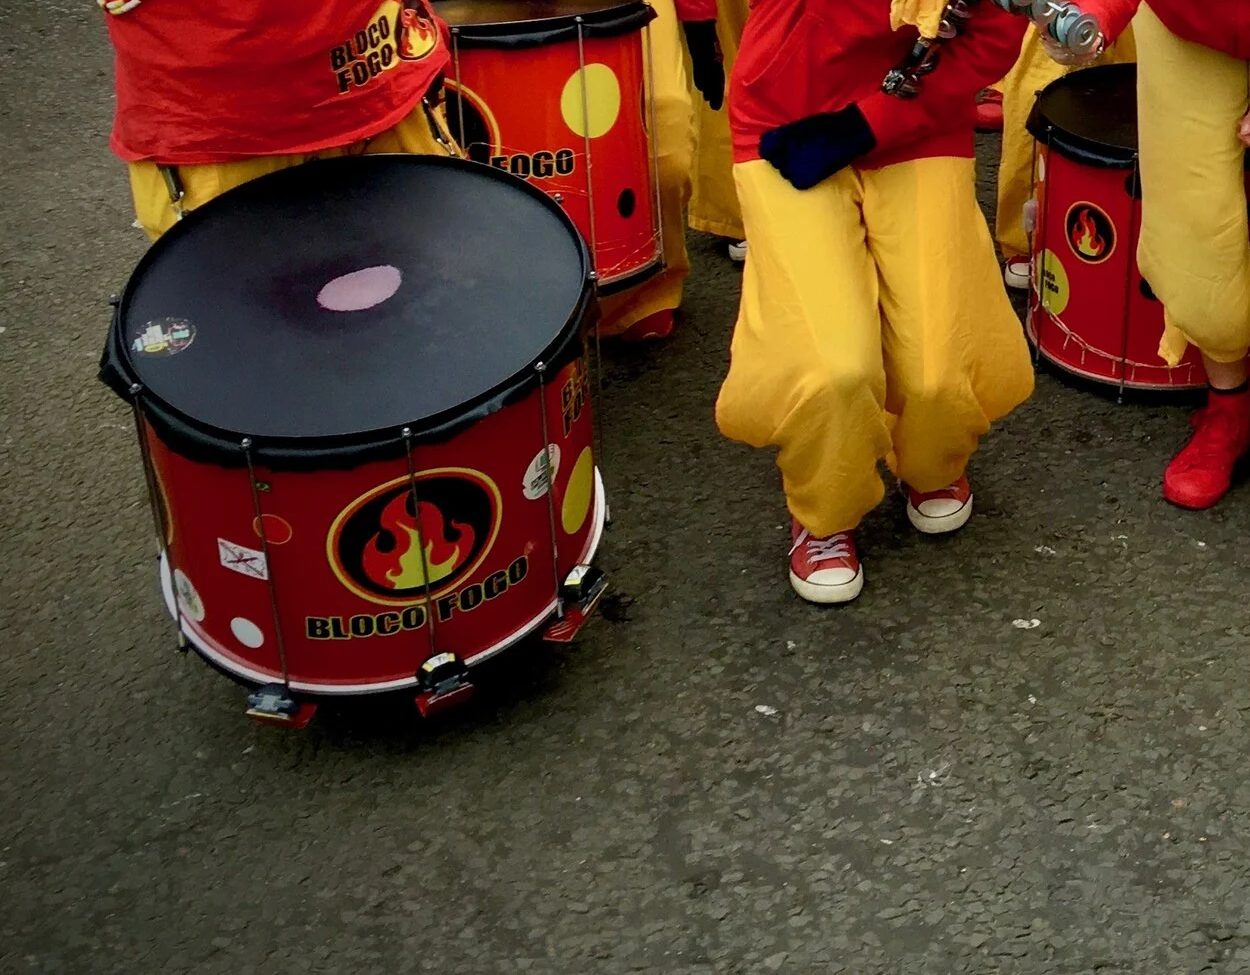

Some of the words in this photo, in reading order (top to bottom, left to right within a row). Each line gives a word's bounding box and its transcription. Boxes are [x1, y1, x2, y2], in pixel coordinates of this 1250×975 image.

[330, 14, 391, 73] BLOCO
[337, 43, 393, 95] FOGO
[306, 605, 427, 640] BLOCO
[436, 554, 529, 622] FOGO
